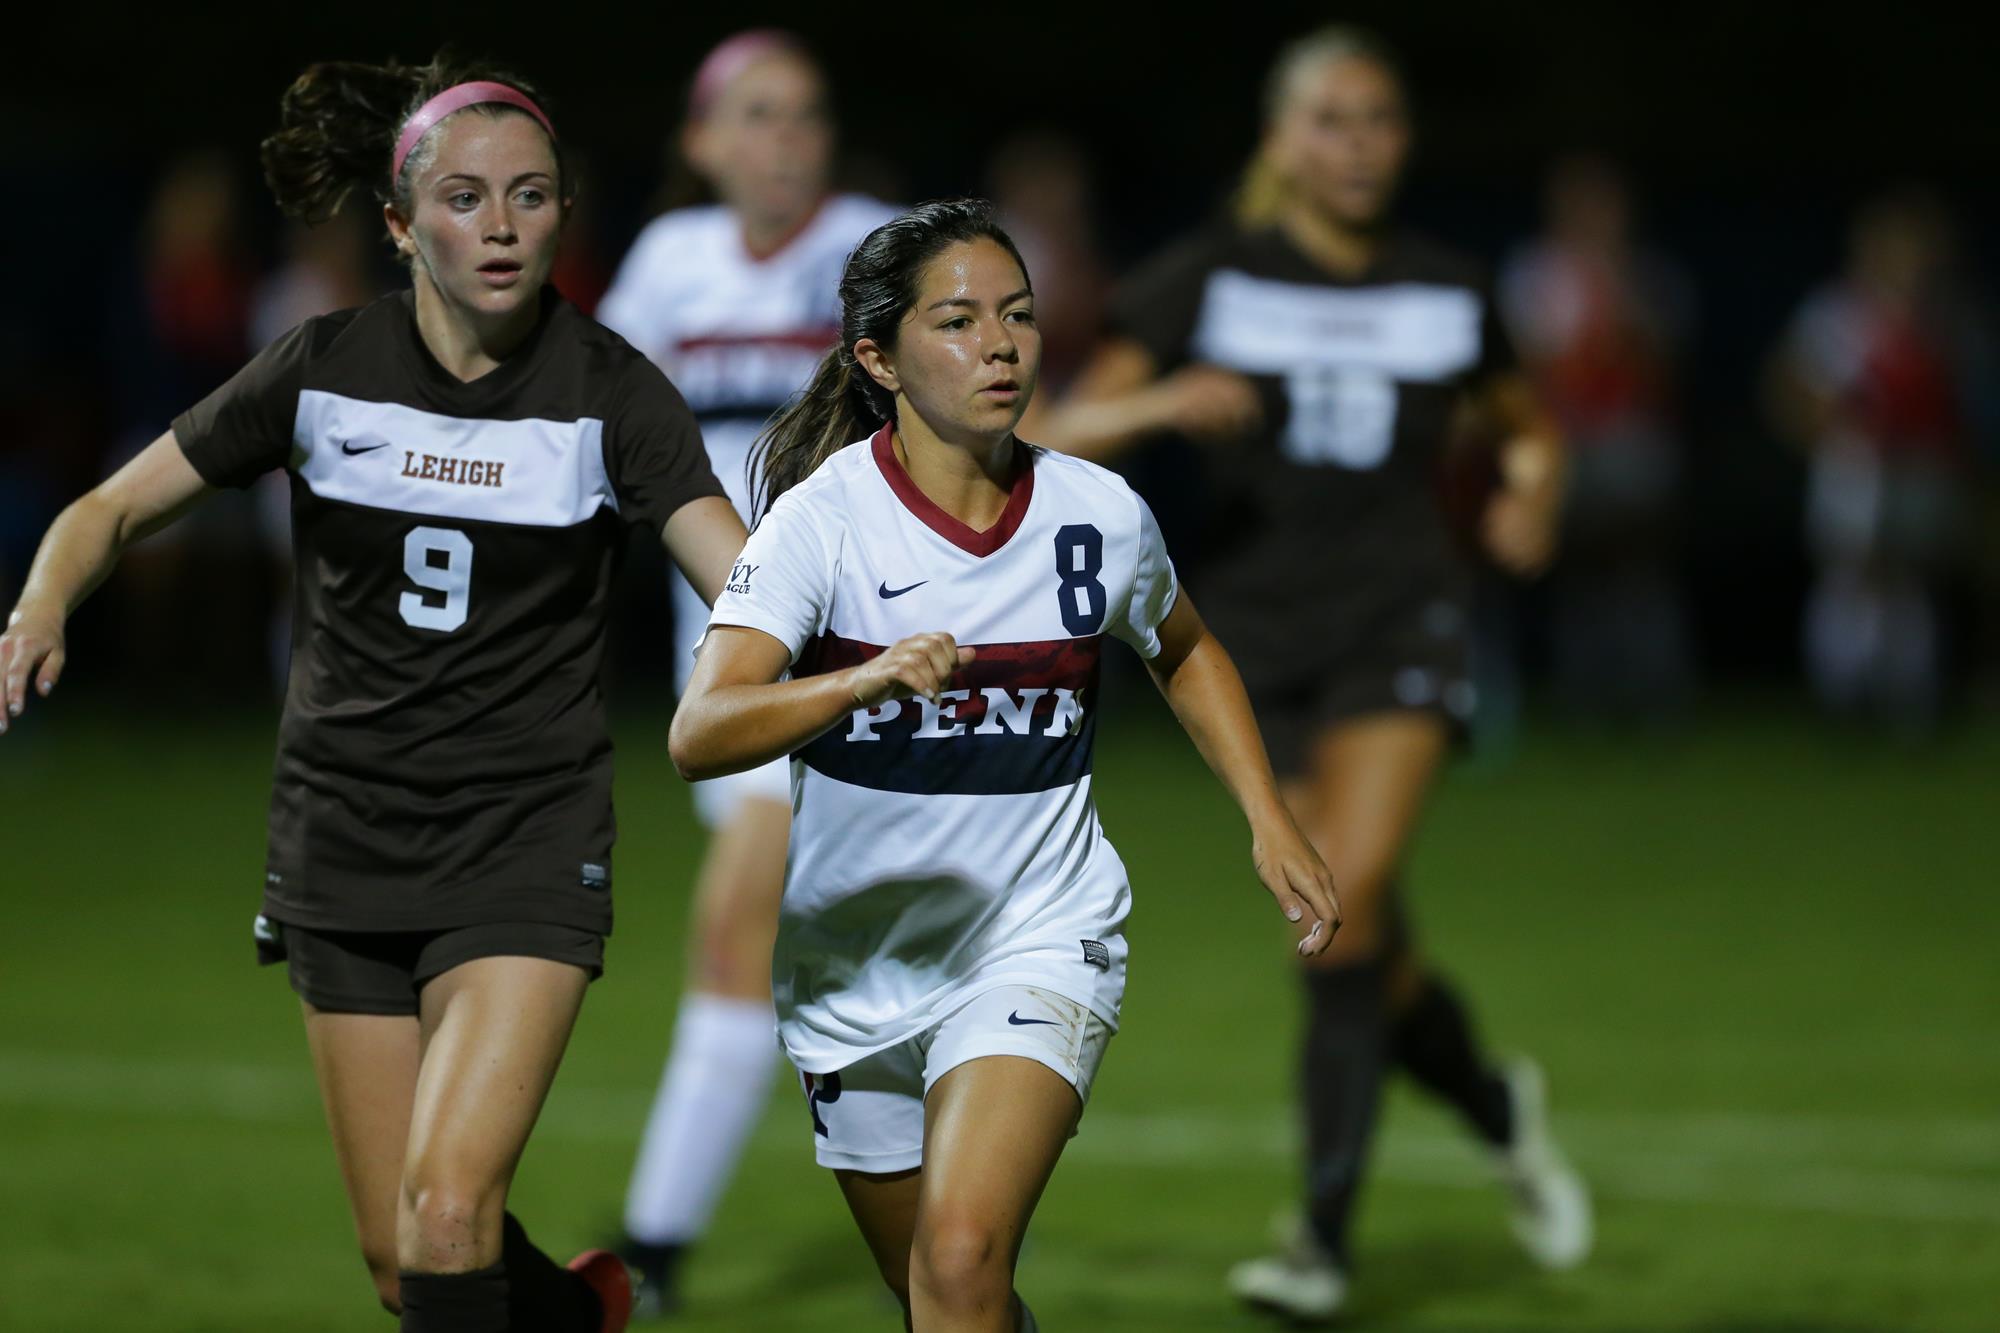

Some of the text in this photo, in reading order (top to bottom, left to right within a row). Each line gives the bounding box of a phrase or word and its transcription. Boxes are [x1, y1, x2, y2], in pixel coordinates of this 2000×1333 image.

[401, 450, 504, 488] LEHIGH
[398, 525, 474, 633] 9
[731, 564, 760, 583] VY
[1053, 523, 1107, 637] 8
[846, 687, 1085, 742] PENN
